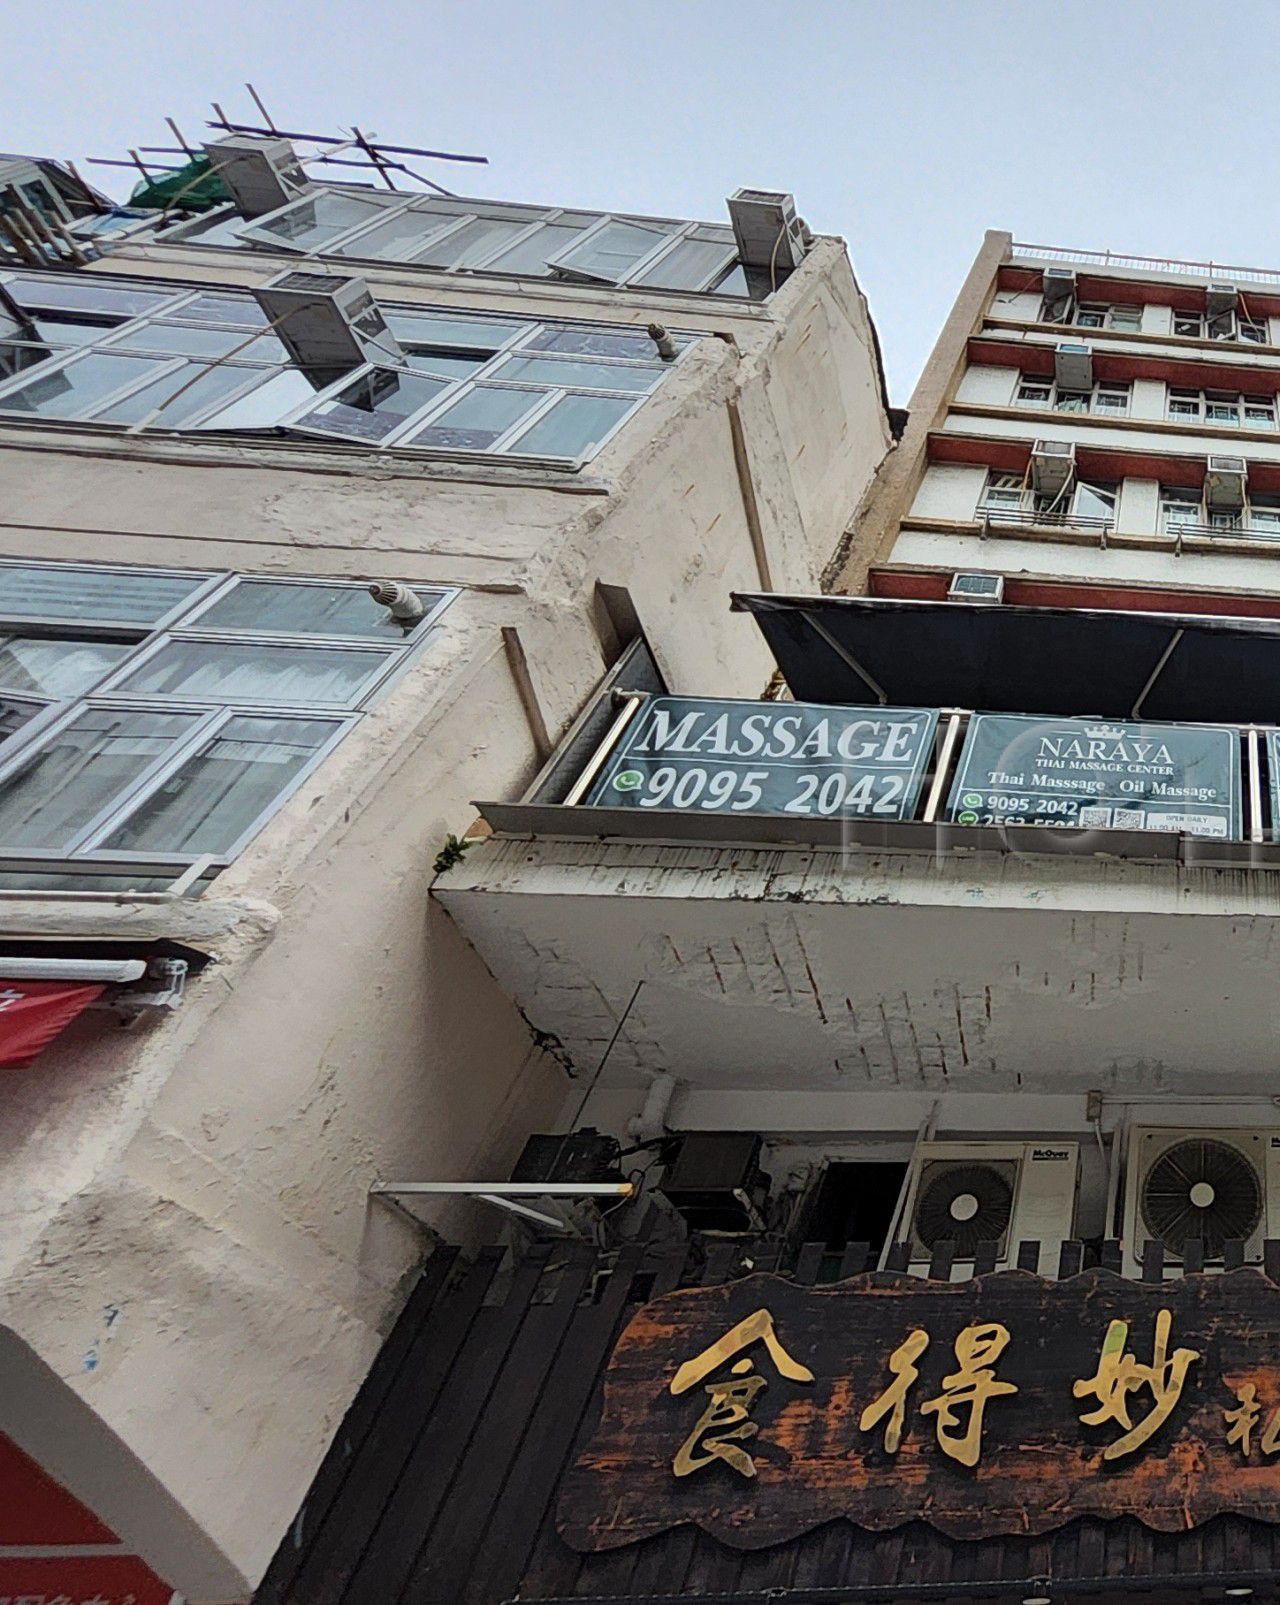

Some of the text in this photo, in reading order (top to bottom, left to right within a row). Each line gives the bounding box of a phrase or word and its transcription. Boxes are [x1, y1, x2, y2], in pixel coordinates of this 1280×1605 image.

[635, 708, 918, 762] MASSAGE
[1037, 737, 1175, 765] NARAYA
[1035, 759, 1175, 776] THAI MASSAGE CENTER
[639, 766, 905, 814] 9095 2042
[988, 772, 1025, 786] Thai
[1119, 779, 1145, 793] Oil
[1151, 782, 1218, 800] Massage
[987, 796, 1079, 815] 9095 2042
